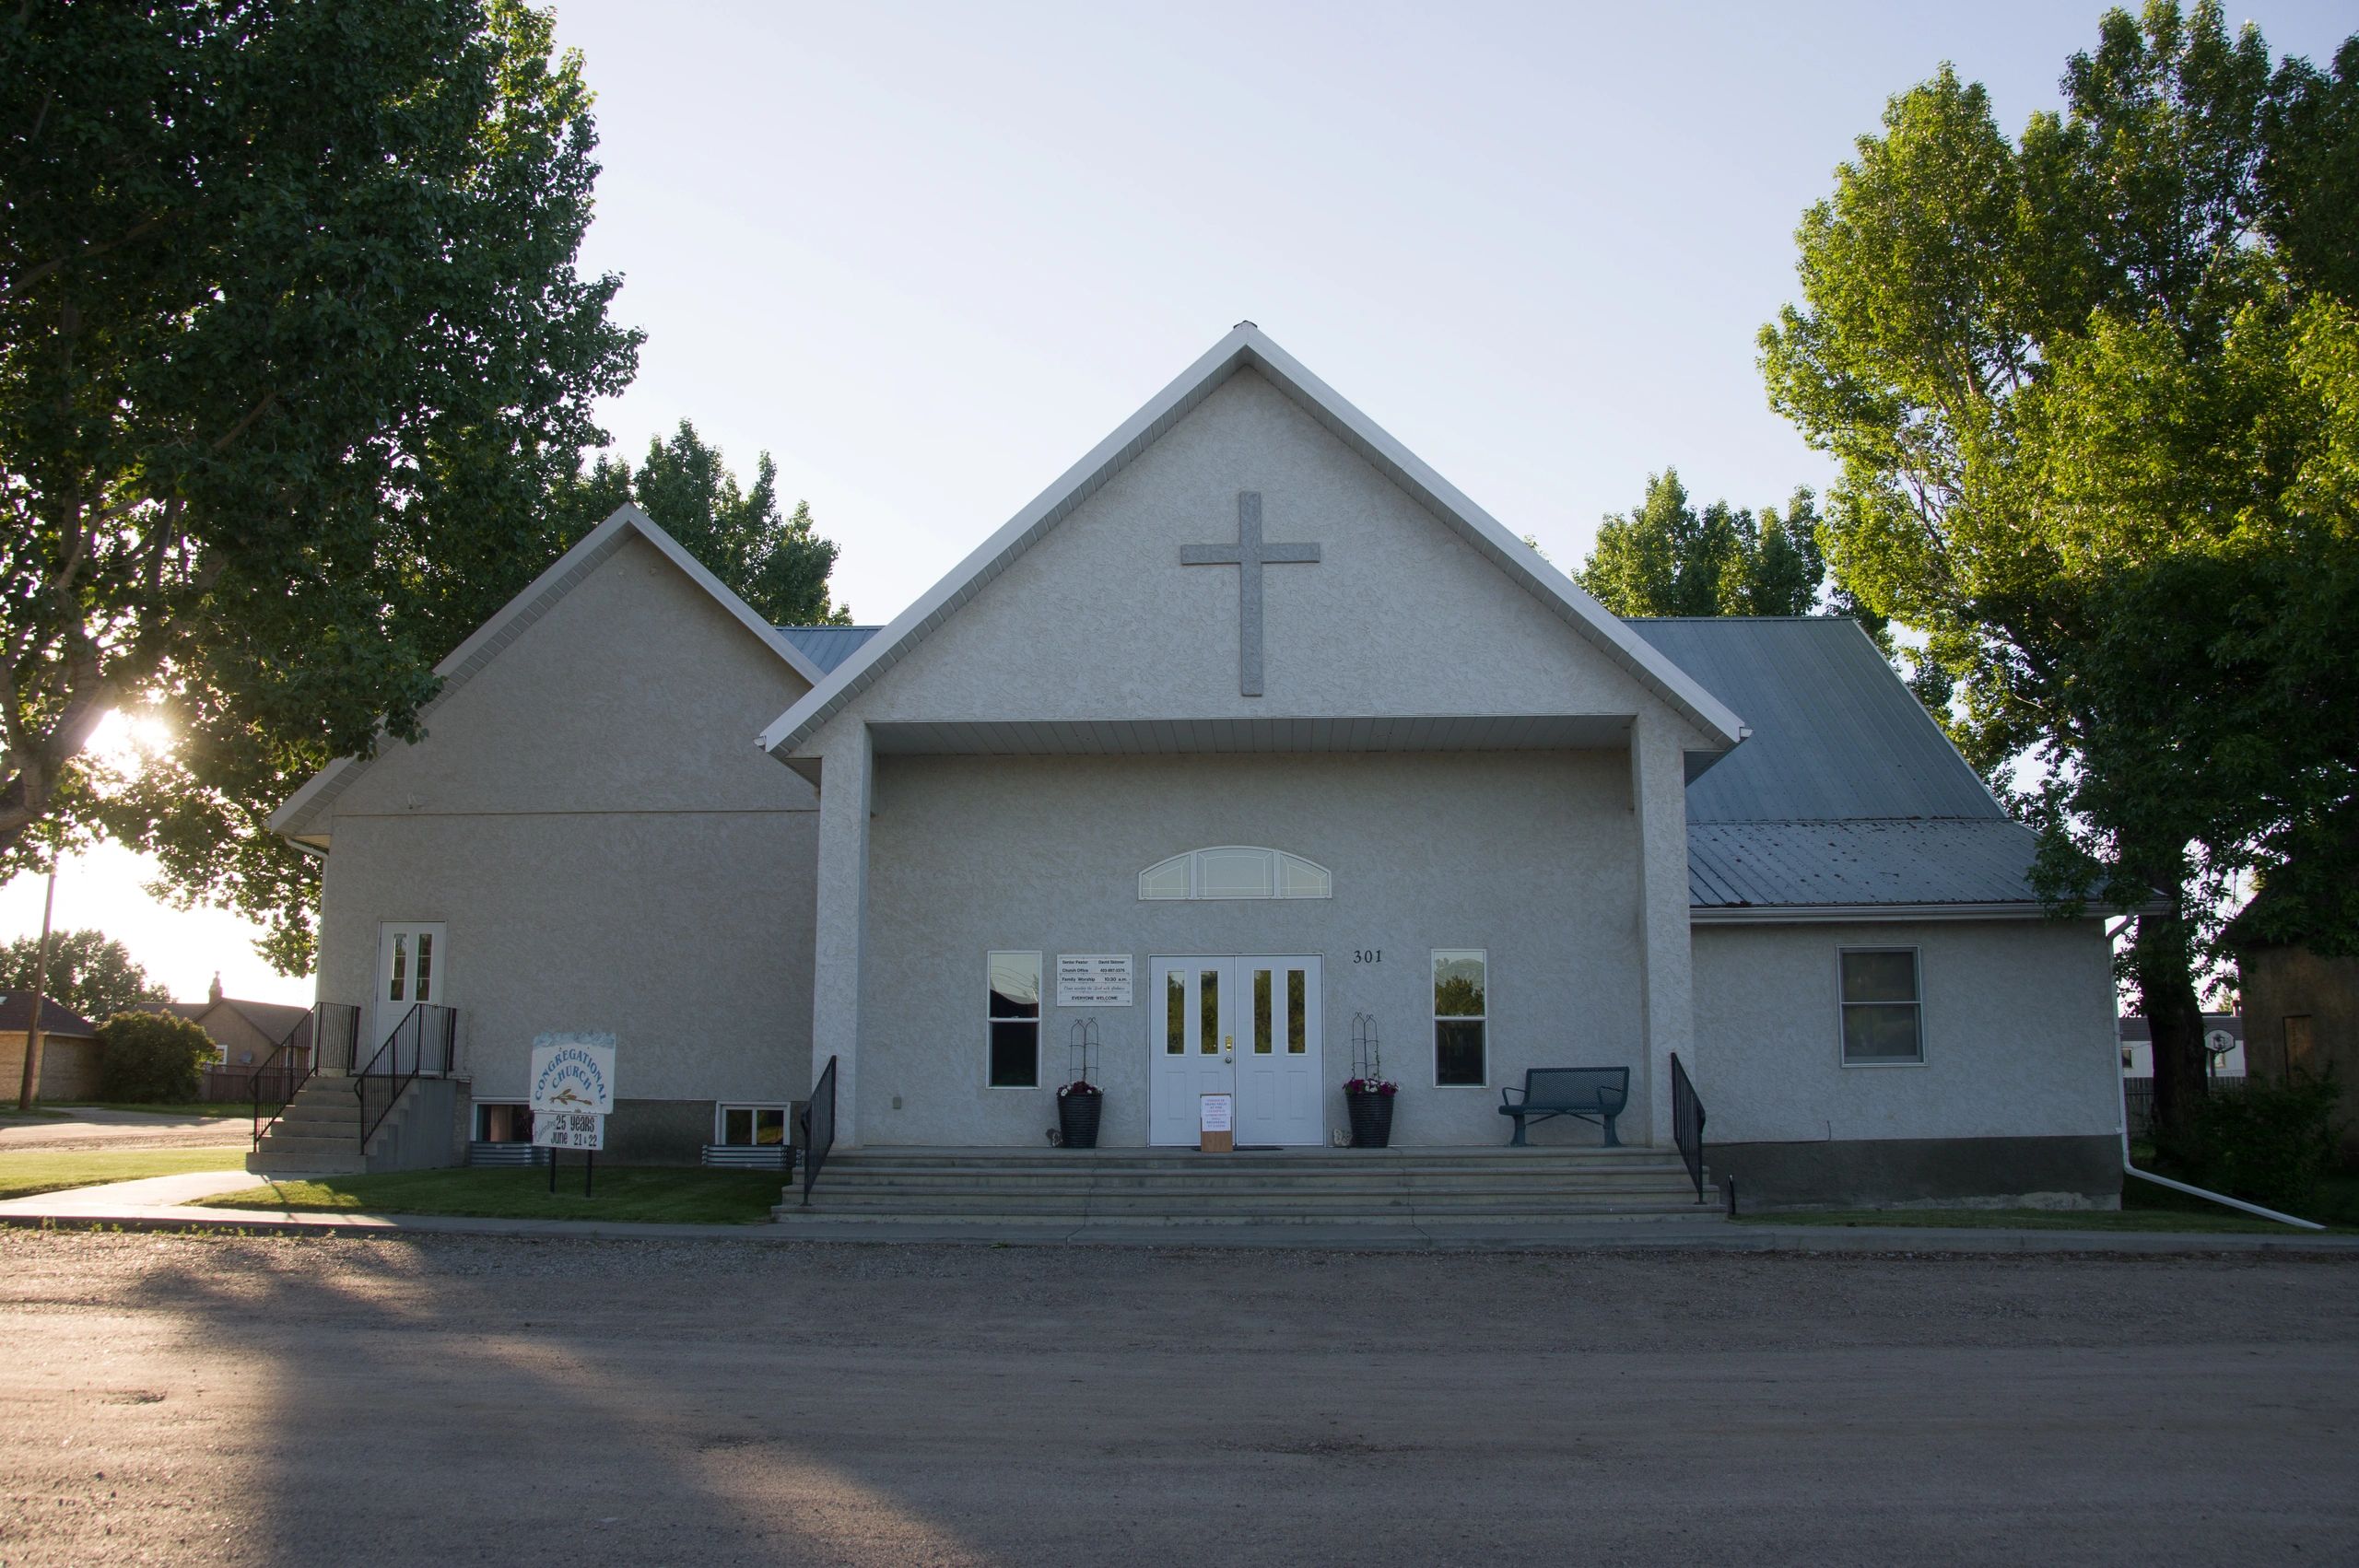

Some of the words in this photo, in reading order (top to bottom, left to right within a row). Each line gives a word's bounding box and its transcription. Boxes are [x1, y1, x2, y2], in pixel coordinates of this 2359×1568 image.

[1353, 950, 1382, 964] 301
[534, 1048, 606, 1105] CONGREGATIONAL
[552, 1065, 592, 1091] CHURCH
[556, 1115, 567, 1130] 25
[550, 1131, 568, 1144] June
[573, 1133, 582, 1146] 21
[588, 1134, 597, 1147] 22
